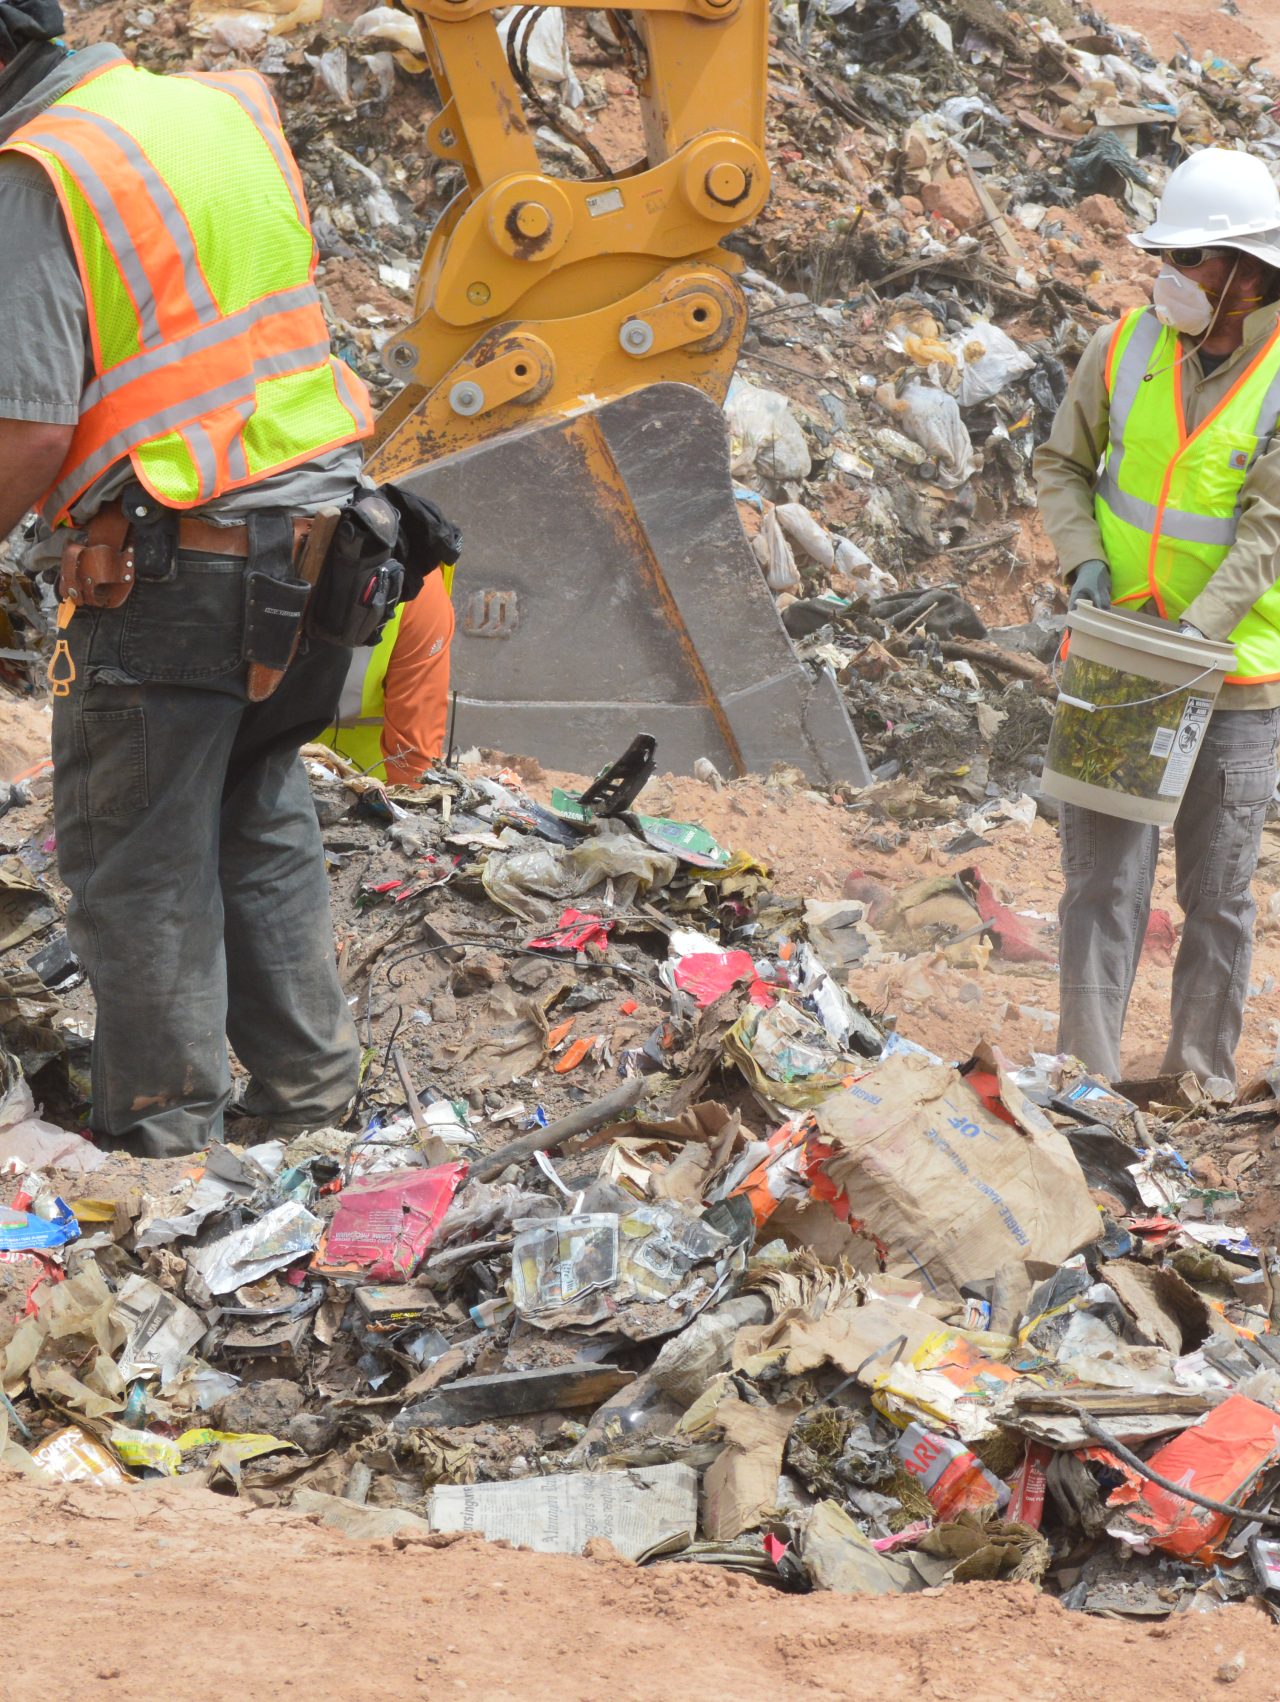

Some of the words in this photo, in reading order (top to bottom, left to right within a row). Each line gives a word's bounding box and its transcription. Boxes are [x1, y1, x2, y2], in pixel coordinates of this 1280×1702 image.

[947, 1116, 980, 1138] OF
[998, 1206, 1030, 1247] FRAGILE
[146, 1316, 163, 1338] ATARI
[581, 1512, 598, 1537] dget
[599, 1513, 614, 1539] ices
